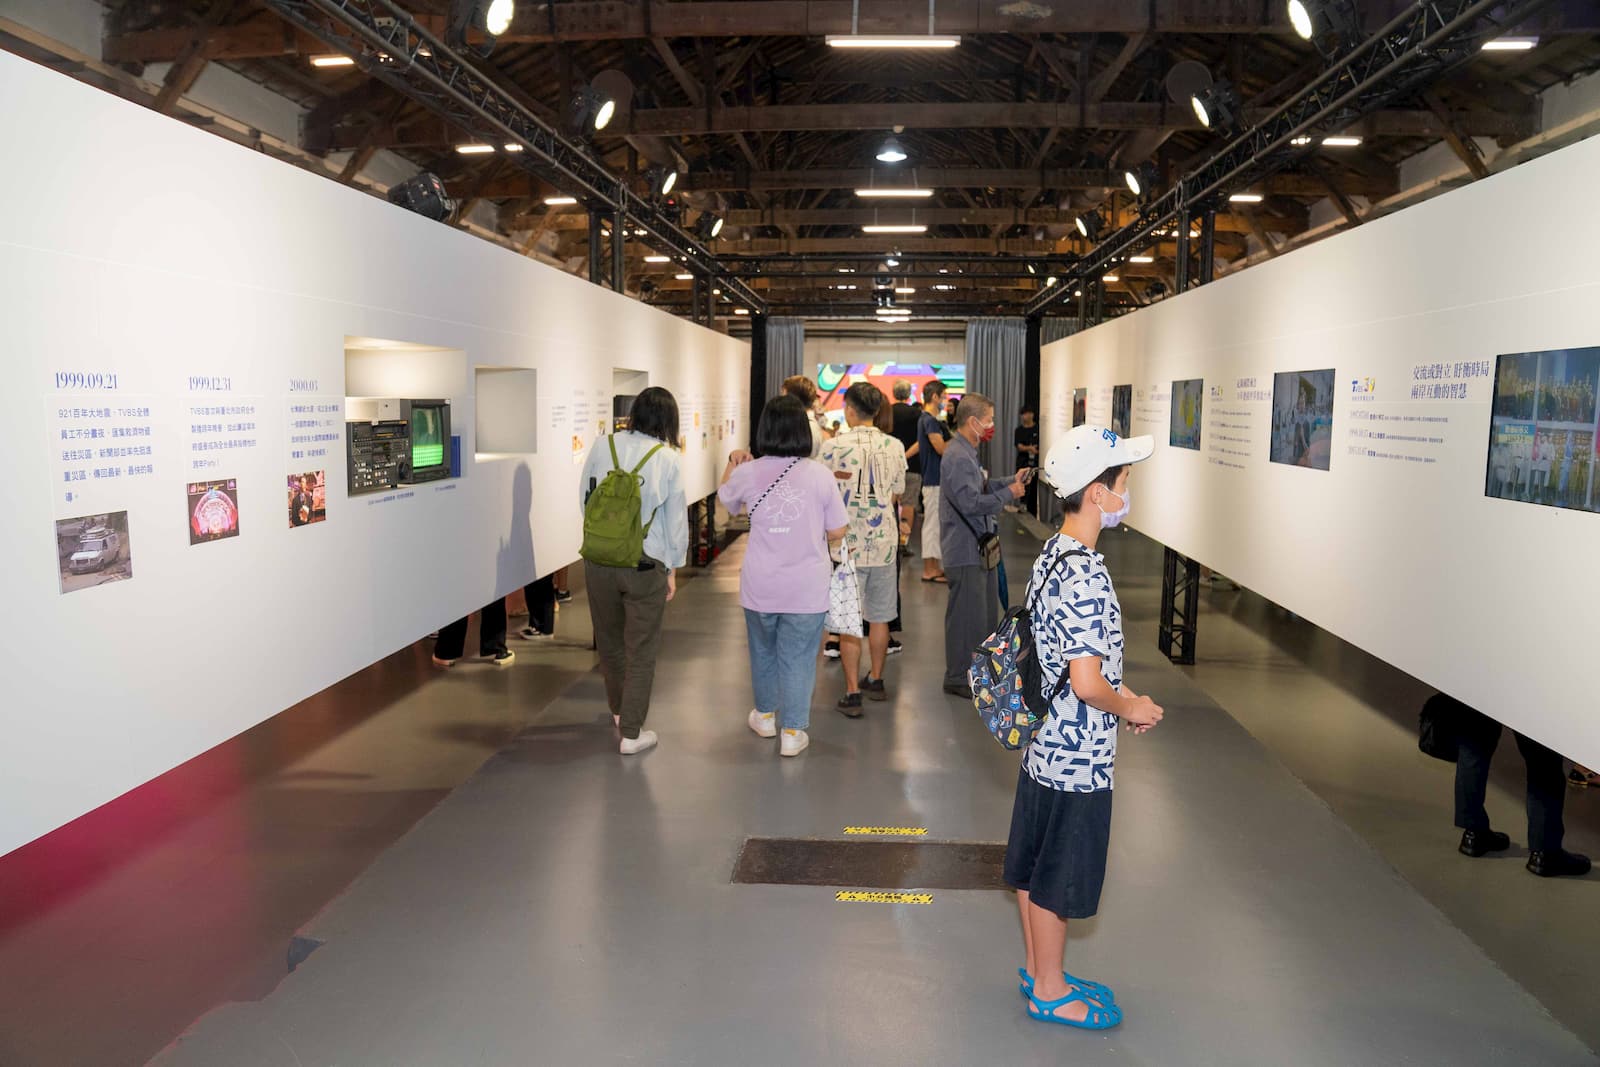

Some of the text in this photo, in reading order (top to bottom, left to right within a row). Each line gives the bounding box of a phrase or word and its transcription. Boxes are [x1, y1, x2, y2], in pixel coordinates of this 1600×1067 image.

[55, 372, 118, 390] 1999.09.21
[189, 376, 232, 391] 1999.12.31
[1411, 383, 1467, 400] 兩岸互動的智慧
